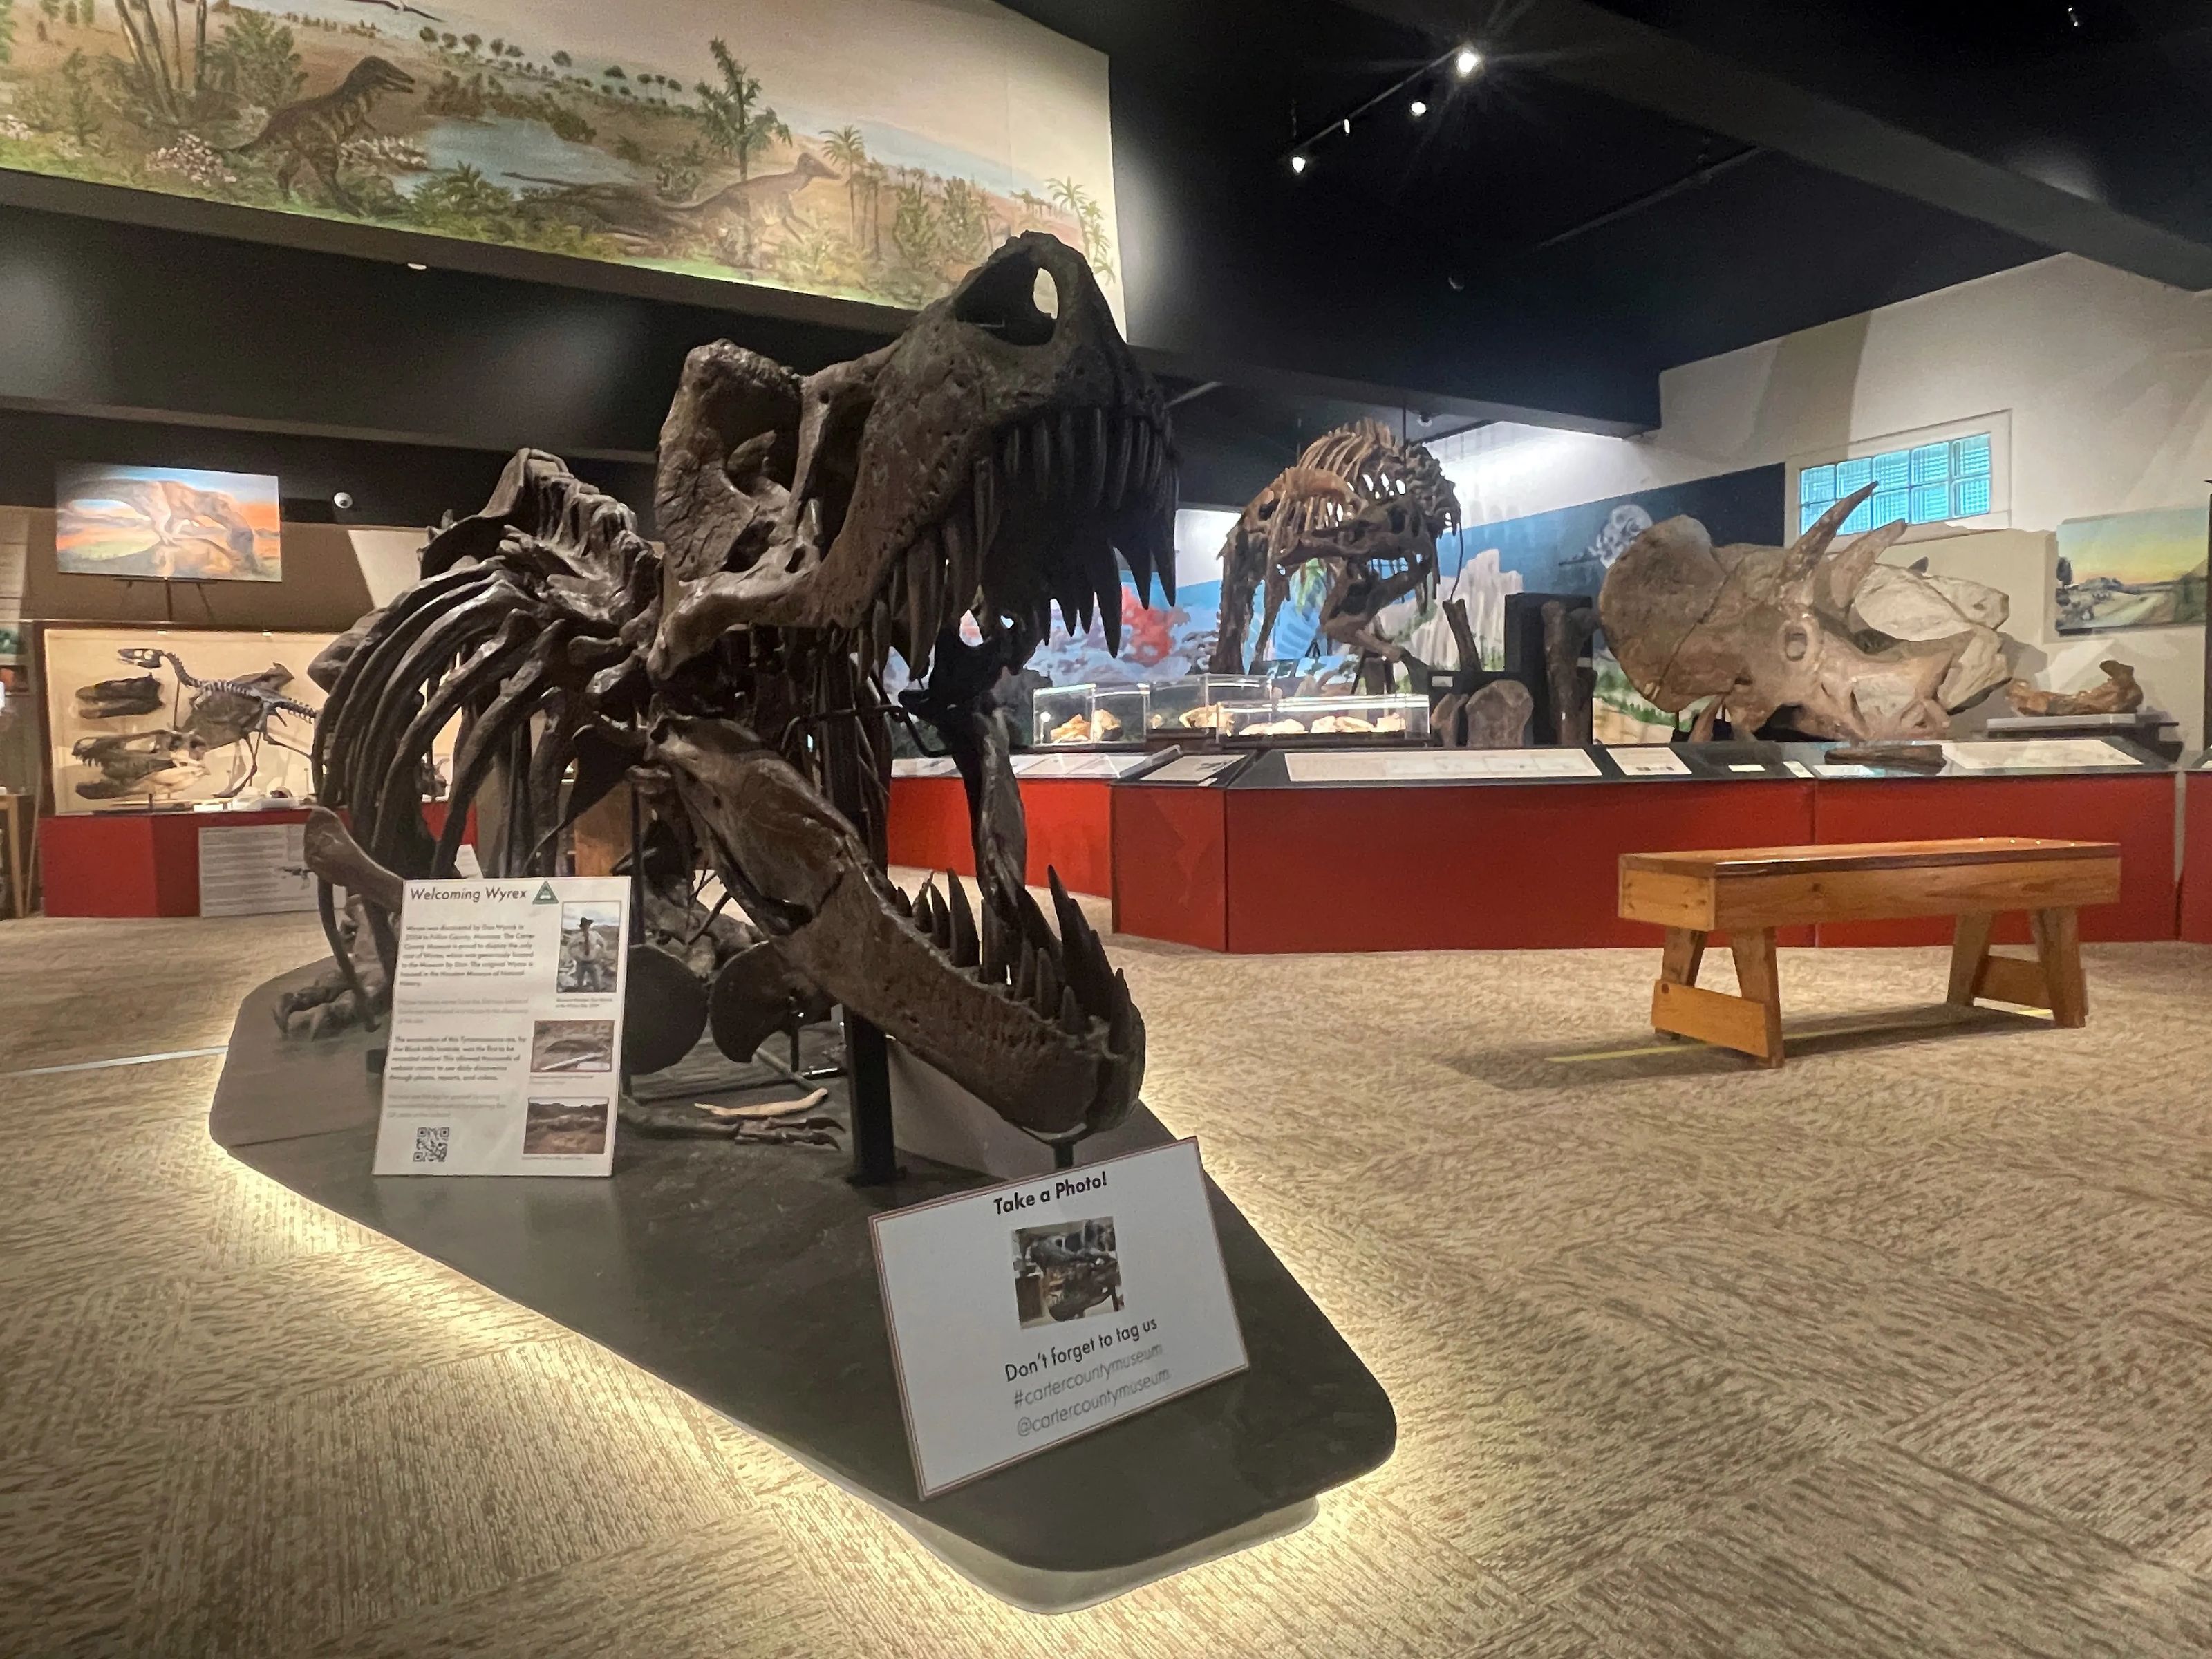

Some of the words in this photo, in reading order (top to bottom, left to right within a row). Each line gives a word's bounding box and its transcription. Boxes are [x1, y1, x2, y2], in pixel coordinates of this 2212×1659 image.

[410, 886, 481, 903] Welcoming
[485, 885, 527, 903] Wyrex
[993, 1191, 1035, 1215] Take
[1040, 1190, 1051, 1203] a
[1056, 1170, 1107, 1199] Photo!
[1004, 1351, 1048, 1382] Don't
[1051, 1337, 1096, 1367] forget
[1098, 1333, 1113, 1349] to
[1116, 1324, 1140, 1342] tag
[1142, 1318, 1158, 1333] us
[1013, 1343, 1163, 1410] #cartercountymuseum
[1016, 1368, 1171, 1437] @cartercountymuseum
